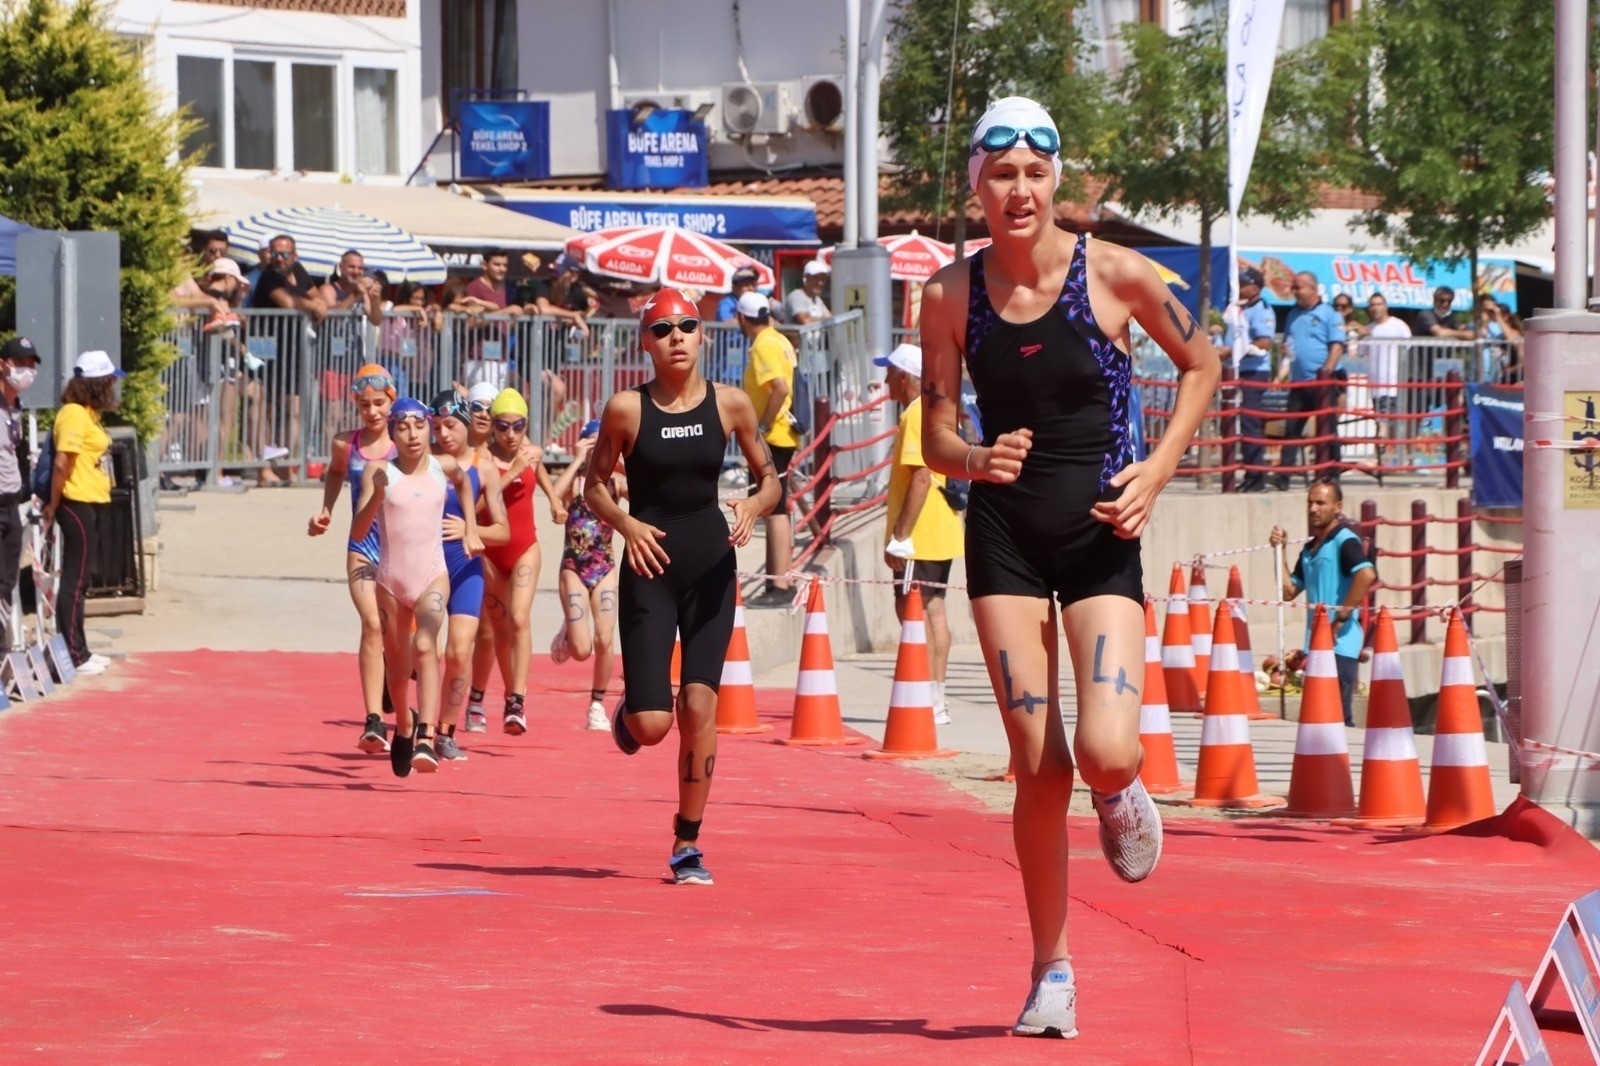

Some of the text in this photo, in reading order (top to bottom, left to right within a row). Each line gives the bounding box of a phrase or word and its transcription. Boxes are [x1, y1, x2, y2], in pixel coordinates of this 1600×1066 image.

[496, 130, 525, 141] ARENA
[497, 141, 520, 152] SHOP
[660, 131, 699, 153] ARENA
[604, 210, 643, 228] ARENA
[683, 212, 716, 233] SHOP
[717, 213, 727, 234] 2
[606, 258, 644, 274] ALGIDA
[675, 270, 716, 284] ALGIDA
[1333, 255, 1425, 287] ÜNAL
[661, 423, 704, 439] arena
[427, 590, 443, 613] 3
[567, 592, 585, 622] 5
[600, 590, 616, 612] 5
[1093, 634, 1139, 696] 4
[999, 649, 1050, 715] 4
